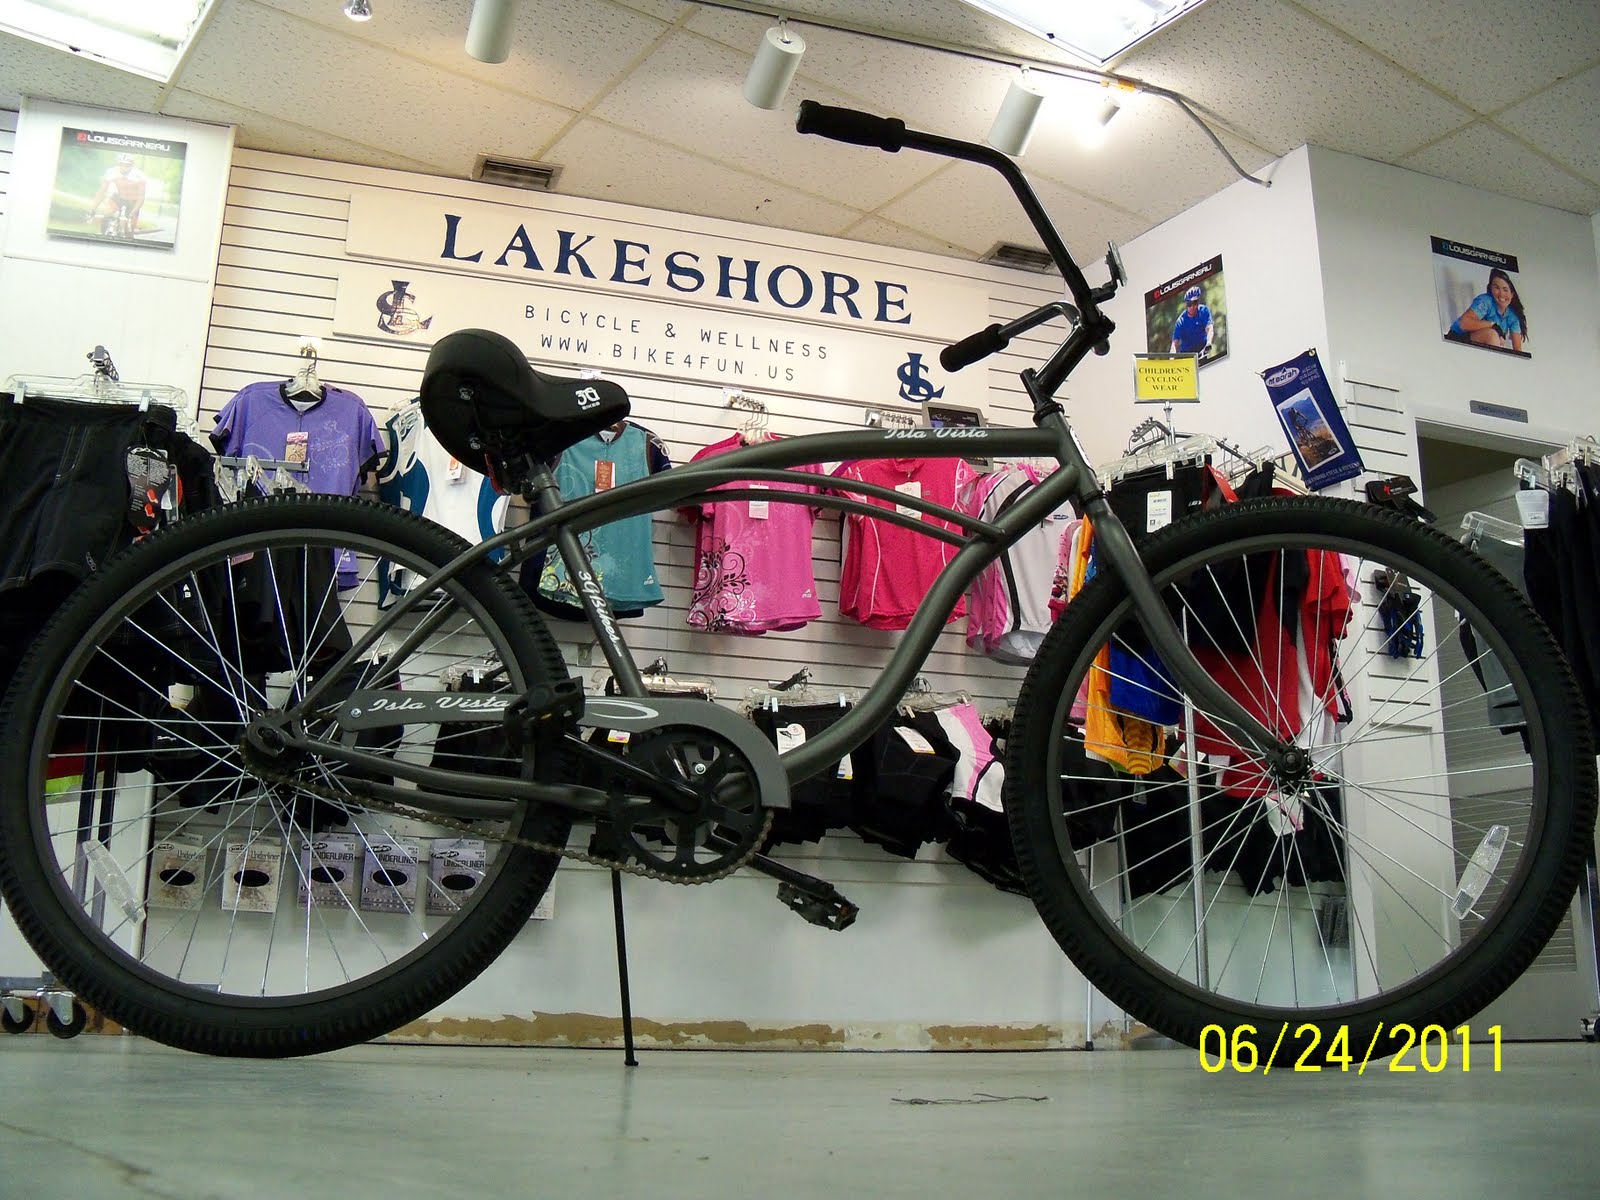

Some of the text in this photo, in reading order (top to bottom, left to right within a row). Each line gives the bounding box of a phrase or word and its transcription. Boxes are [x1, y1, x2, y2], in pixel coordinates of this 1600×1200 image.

[440, 213, 912, 325] LAKESHORE
[524, 305, 828, 360] BICYCLE & WELLNESS
[1138, 367, 1190, 375] CHILDREN'S
[884, 427, 989, 439] Isla Vista
[367, 696, 511, 712] Isla Vista
